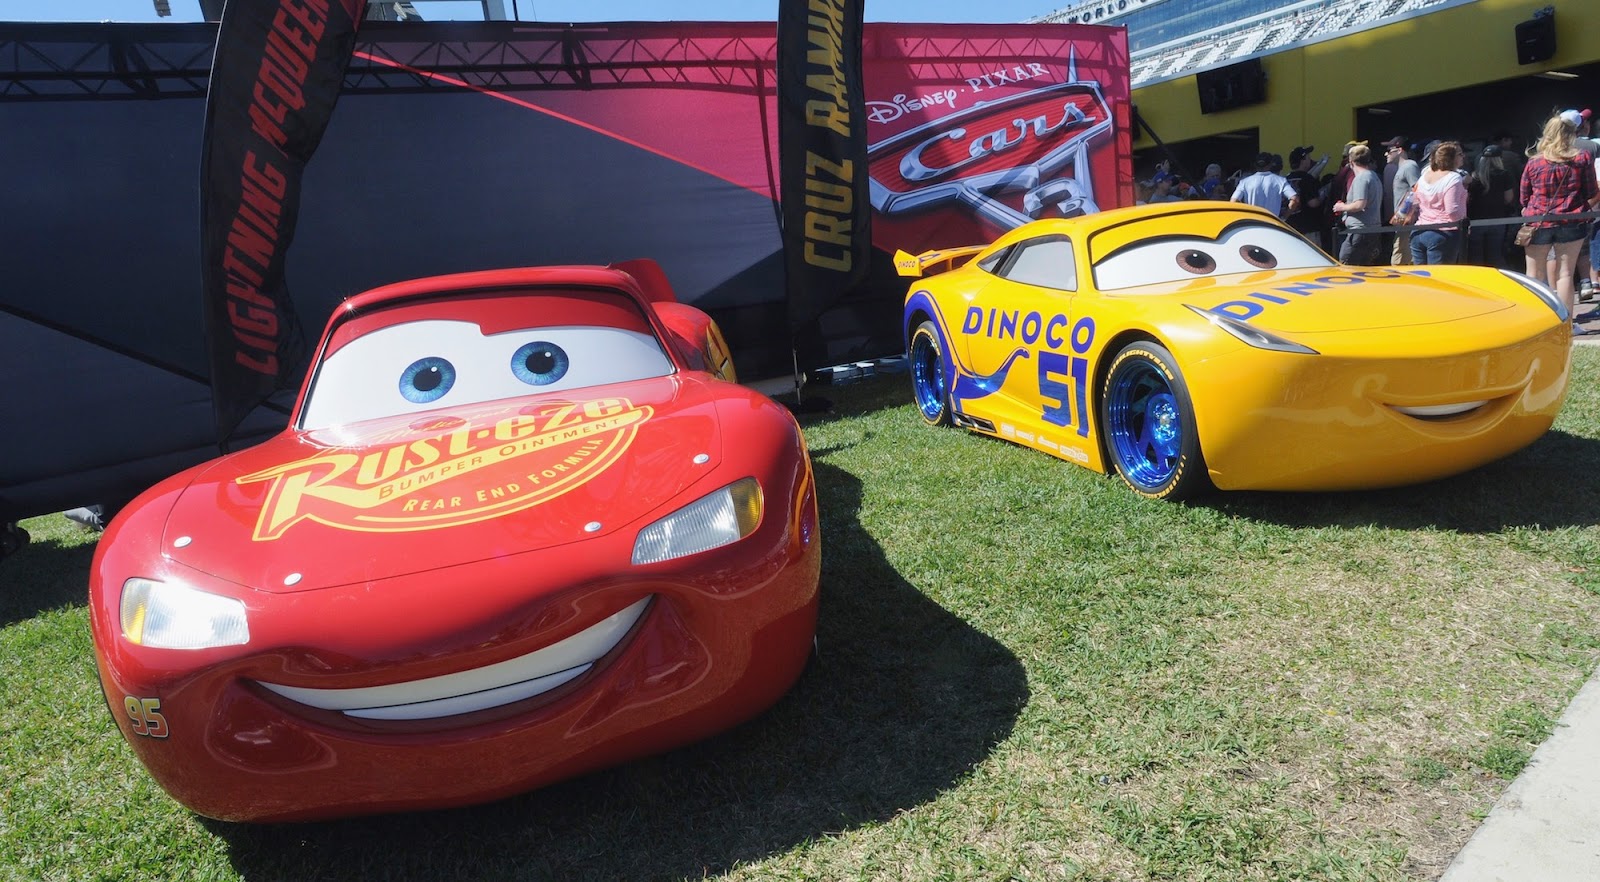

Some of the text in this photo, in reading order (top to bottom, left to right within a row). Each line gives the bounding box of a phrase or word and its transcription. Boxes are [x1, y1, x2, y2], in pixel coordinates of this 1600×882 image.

[1068, 0, 1128, 23] WORLD
[965, 62, 1049, 94] PIXAR
[804, 0, 853, 272] CRUZ RAMIR
[899, 102, 1096, 181] Cars
[223, 150, 287, 376] LIGHTNING
[962, 306, 1096, 354] DINOCO
[1038, 350, 1089, 438] 51
[402, 439, 604, 512] REAR END FORMULA
[124, 695, 169, 738] 95
